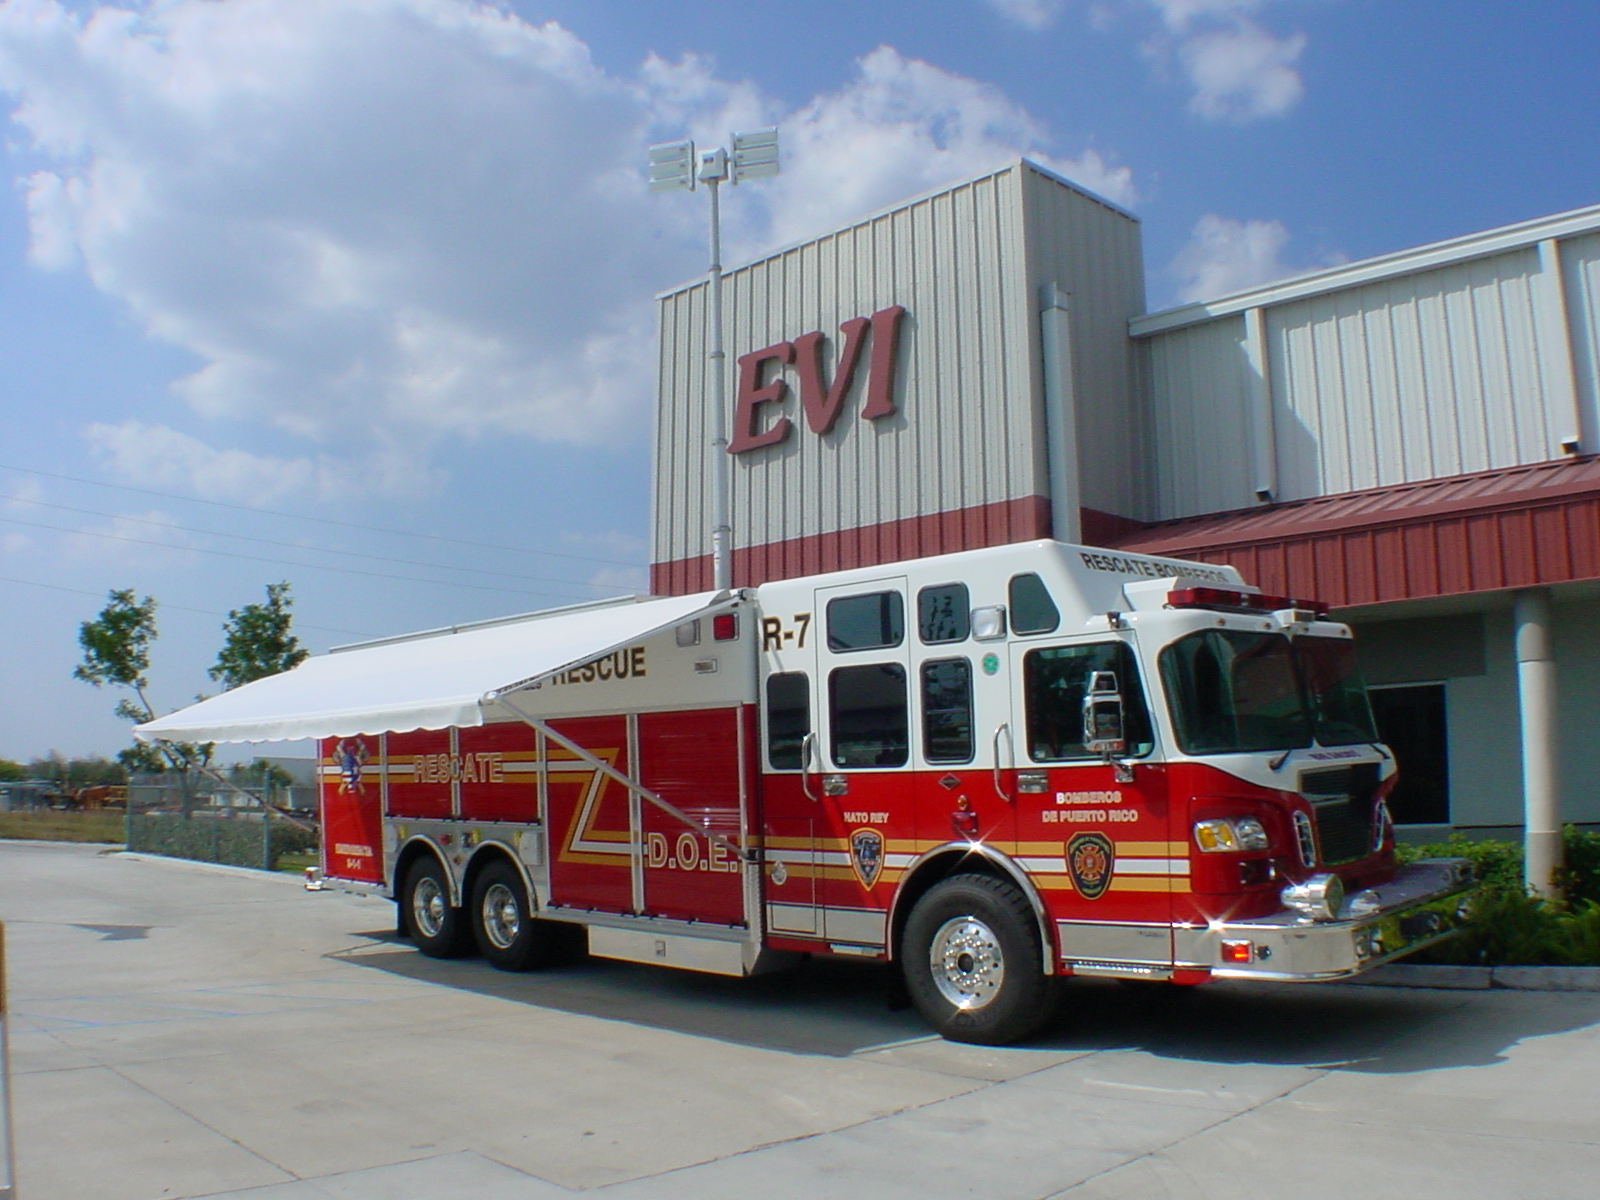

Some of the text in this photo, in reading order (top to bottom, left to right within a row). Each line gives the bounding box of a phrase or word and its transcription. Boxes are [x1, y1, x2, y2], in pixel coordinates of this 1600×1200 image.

[726, 304, 906, 454] EVI
[1080, 552, 1155, 577] RESCATE
[762, 612, 811, 652] R-7
[413, 753, 504, 783] RESCATE
[1056, 791, 1122, 804] BOMBEROS
[1042, 809, 1138, 822] DE PUERTO RICO
[648, 832, 738, 872] D.O.E.
